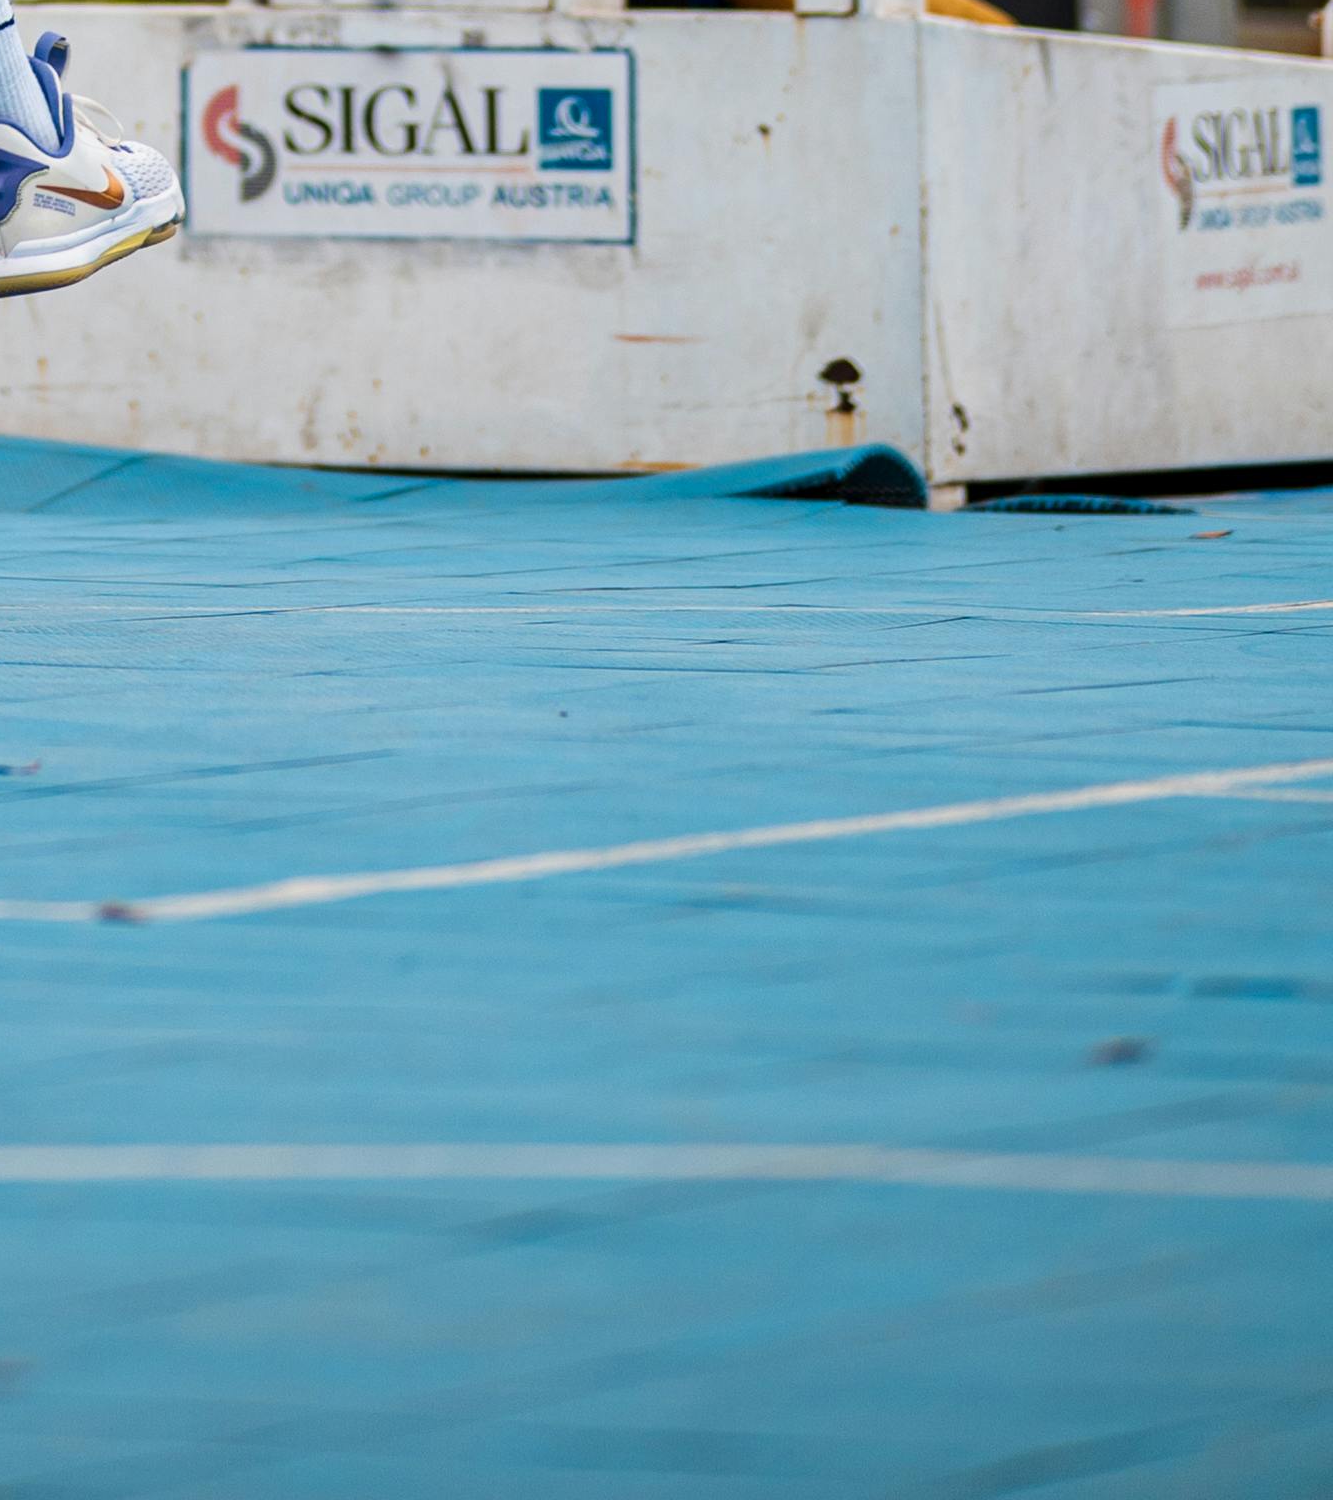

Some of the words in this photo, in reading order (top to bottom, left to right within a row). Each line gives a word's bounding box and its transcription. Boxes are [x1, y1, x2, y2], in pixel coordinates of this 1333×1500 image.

[283, 83, 529, 156] SIGAL
[1191, 106, 1290, 183] SIGAL
[283, 181, 375, 207] UNIQA
[386, 182, 483, 208] GROUP
[492, 182, 614, 209] AUSTRIA
